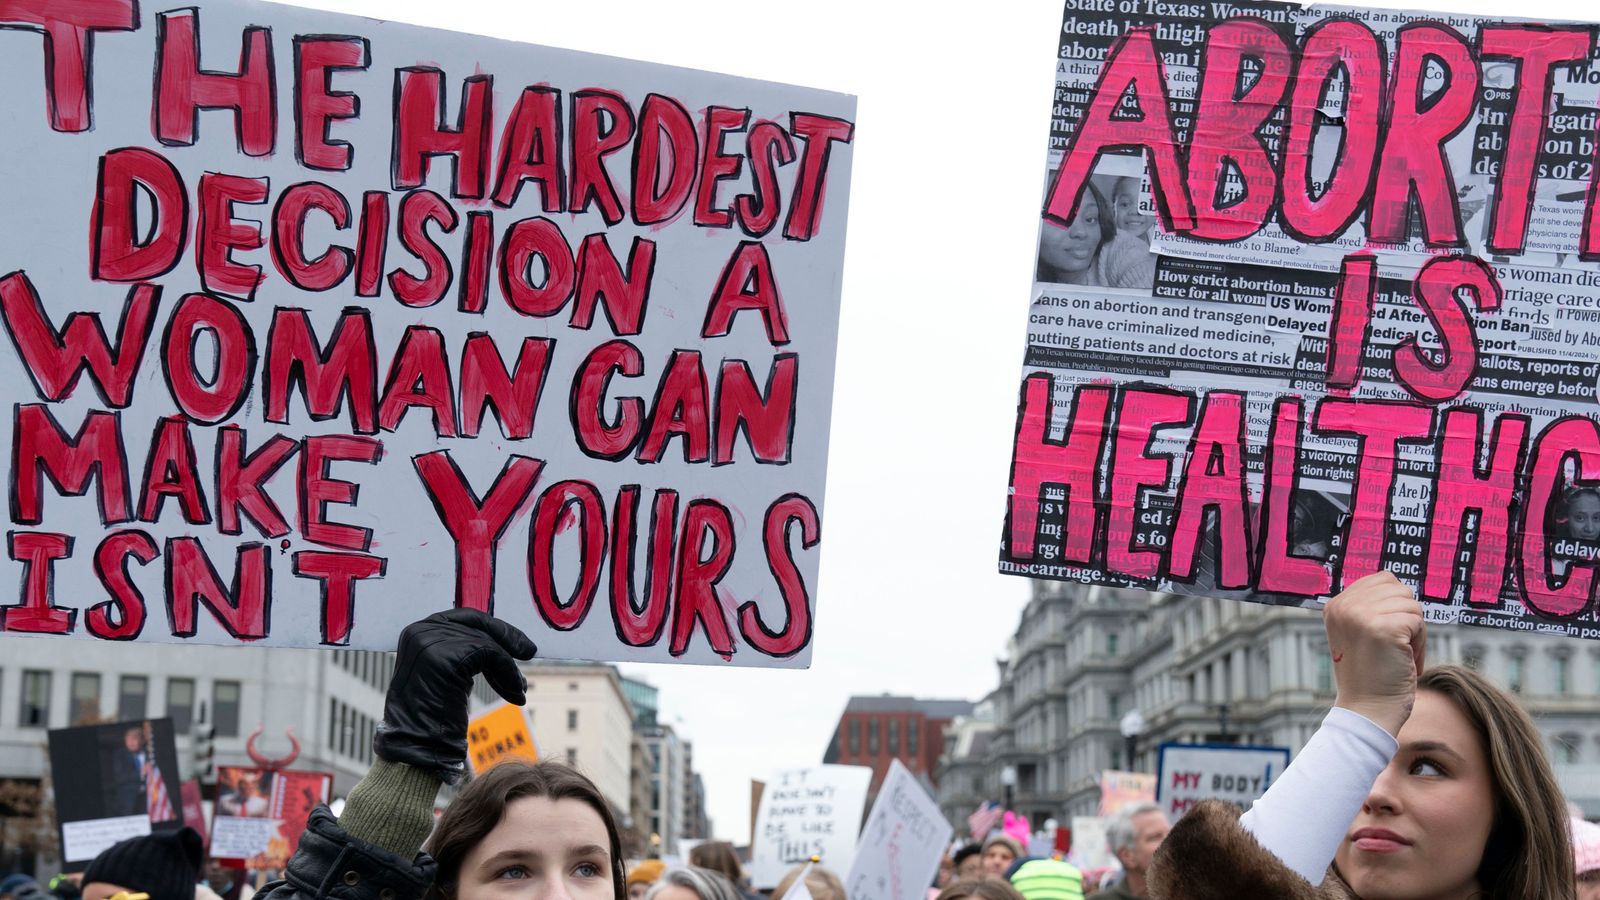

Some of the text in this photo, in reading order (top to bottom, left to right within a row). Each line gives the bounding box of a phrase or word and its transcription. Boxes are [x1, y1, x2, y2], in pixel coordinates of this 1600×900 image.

[1066, 0, 1298, 24] State of Texas: Woman's
[1373, 12, 1388, 22] an
[1448, 17, 1470, 28] but
[1063, 17, 1119, 36] death
[1058, 62, 1067, 73] A
[1070, 63, 1100, 75] third
[1056, 80, 1069, 88] as
[1495, 92, 1511, 100] PBS
[0, 0, 855, 241] THE HARDEST
[1552, 161, 1579, 179] of
[1539, 205, 1560, 213] Texas
[1547, 218, 1561, 226] she
[89, 147, 791, 346] DECISION A
[1251, 240, 1261, 250] to
[1264, 243, 1301, 256] Blame?
[1160, 246, 1192, 256] Physicians
[1193, 250, 1208, 258] need
[1208, 252, 1225, 260] more
[1226, 253, 1240, 261] clear
[1241, 255, 1269, 265] guidance
[1270, 257, 1282, 265] and
[1283, 258, 1312, 270] protocols
[1313, 262, 1328, 271] from
[1158, 269, 1327, 297] How strict abortion bans
[1510, 268, 1572, 285] woman
[1156, 284, 1229, 301] care for all
[1072, 299, 1090, 309] on
[1094, 300, 1158, 315] abortion
[1161, 306, 1190, 319] and
[1557, 296, 1593, 309] care
[1270, 296, 1530, 333] US After Ban
[1029, 314, 1276, 347] care have criminalized medicine,
[1267, 315, 1328, 333] Delayed
[1330, 254, 1502, 405] IS
[1564, 329, 1579, 346] by
[0, 270, 556, 440] WOMAN
[1028, 331, 1291, 366] putting patients and doctors at risk
[1518, 346, 1600, 361] PUBLISHED 11/4/2024 by
[1029, 357, 1057, 368] abortion
[1072, 361, 1107, 372] ProPublica
[1107, 365, 1136, 376] reported
[1136, 367, 1148, 375] last
[1148, 369, 1167, 377] week.
[1031, 347, 1045, 355] Two
[1046, 348, 1065, 357] Texas
[1065, 350, 1089, 359] women
[1090, 352, 1104, 360] died
[1105, 353, 1120, 362] after
[1120, 354, 1136, 364] they
[1136, 355, 1154, 365] faced
[1155, 357, 1175, 368] delays
[1176, 359, 1183, 367] in
[1183, 360, 1206, 371] getting
[1206, 362, 1243, 375] miscarriage
[1244, 366, 1259, 375] care
[1260, 367, 1286, 377] because
[1286, 369, 1294, 378] of
[1294, 370, 1306, 378] the
[1528, 360, 1580, 378] reports
[1582, 363, 1599, 378] of
[1501, 378, 1554, 396] emerge
[1358, 385, 1389, 398] Judge
[1507, 403, 1557, 418] Abortion
[1308, 451, 1345, 465] victory
[1409, 460, 1426, 472] for
[8, 403, 386, 553] MAKE
[1398, 482, 1418, 499] Are
[1399, 503, 1420, 518] and
[0, 449, 821, 661] ISN'T YOURS
[999, 560, 1106, 584] miscarriage.
[1459, 609, 1478, 624] for
[1480, 614, 1534, 631] abortion
[1536, 622, 1565, 634] care
[1567, 623, 1579, 636] in
[470, 726, 489, 744] NO
[1171, 770, 1202, 790] MY
